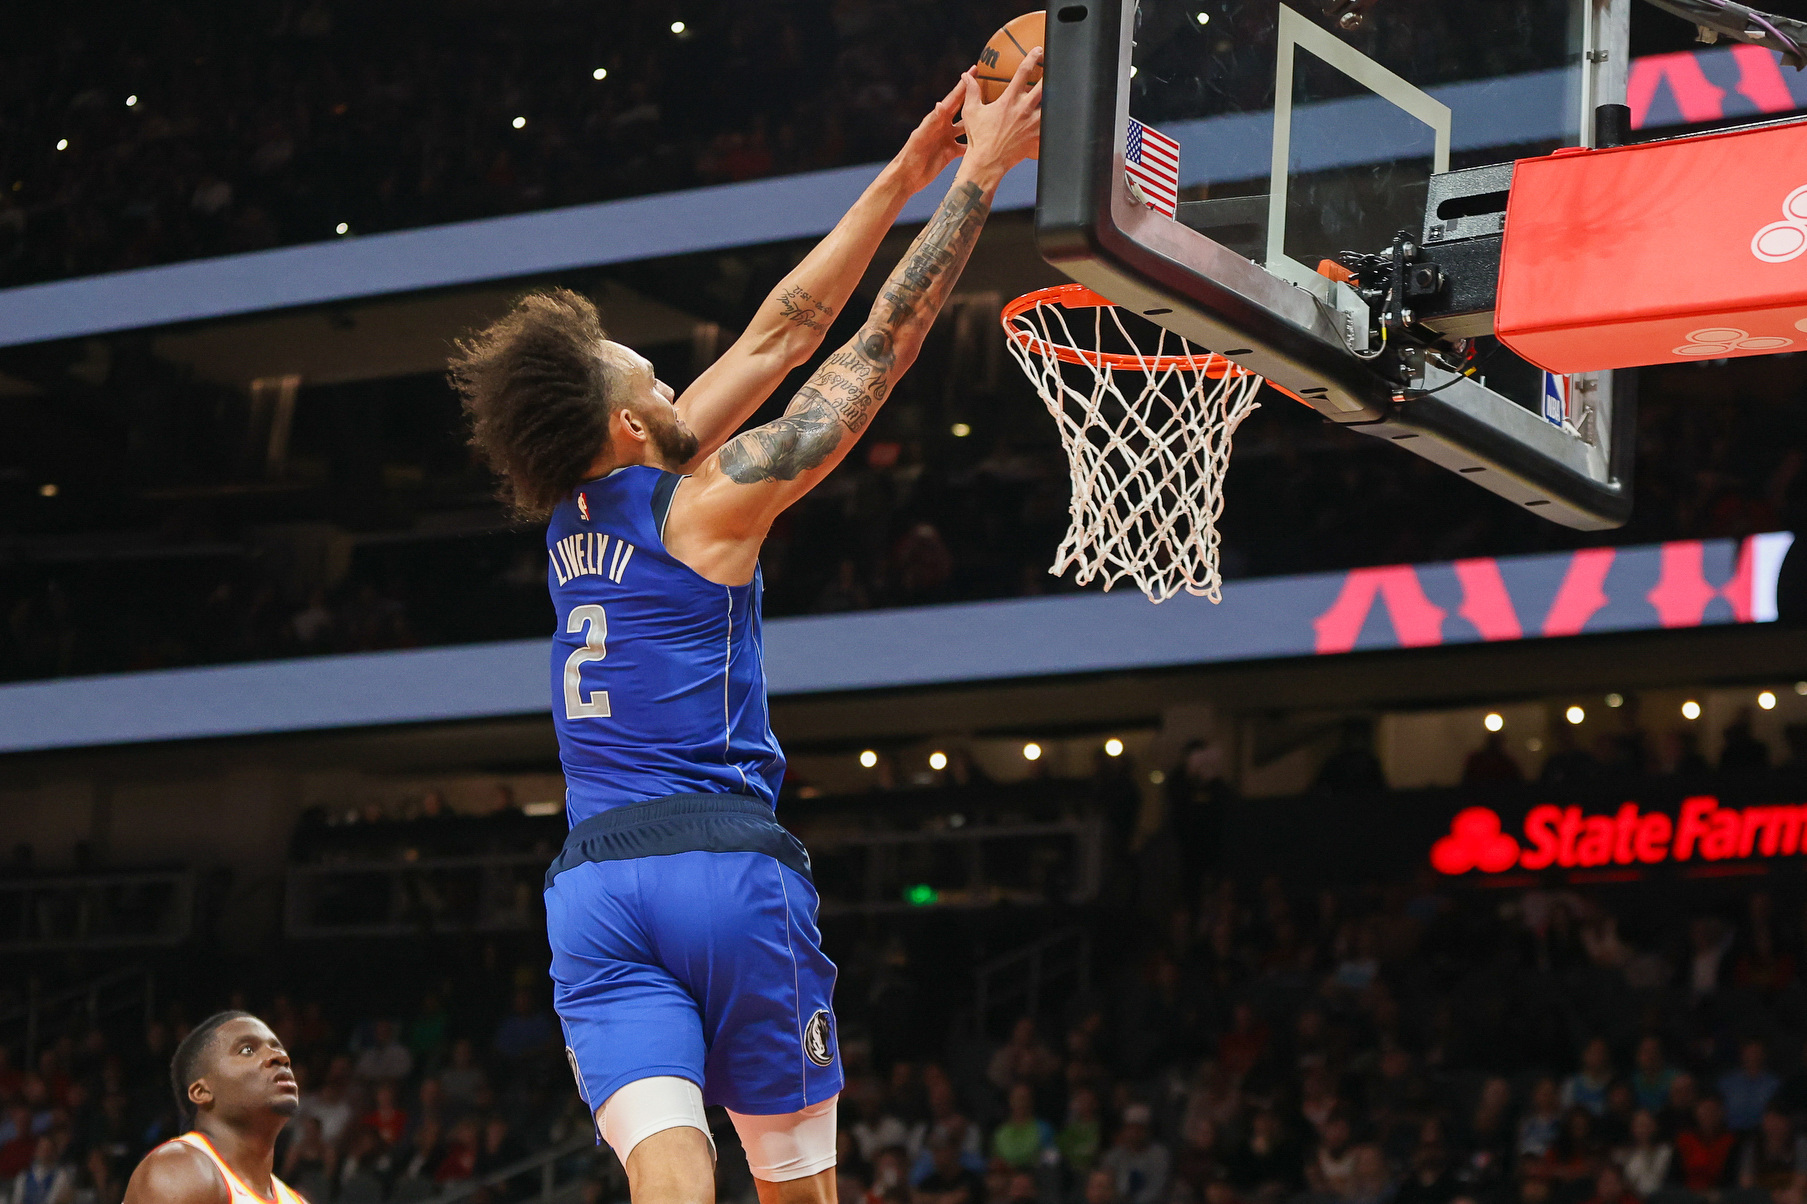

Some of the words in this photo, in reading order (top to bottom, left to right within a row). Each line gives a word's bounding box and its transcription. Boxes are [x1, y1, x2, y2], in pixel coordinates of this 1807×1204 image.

[549, 532, 609, 587] LIVELY
[608, 539, 635, 584] II
[563, 603, 611, 720] 2
[1518, 803, 1674, 871] State
[1673, 795, 1807, 863] Farm
